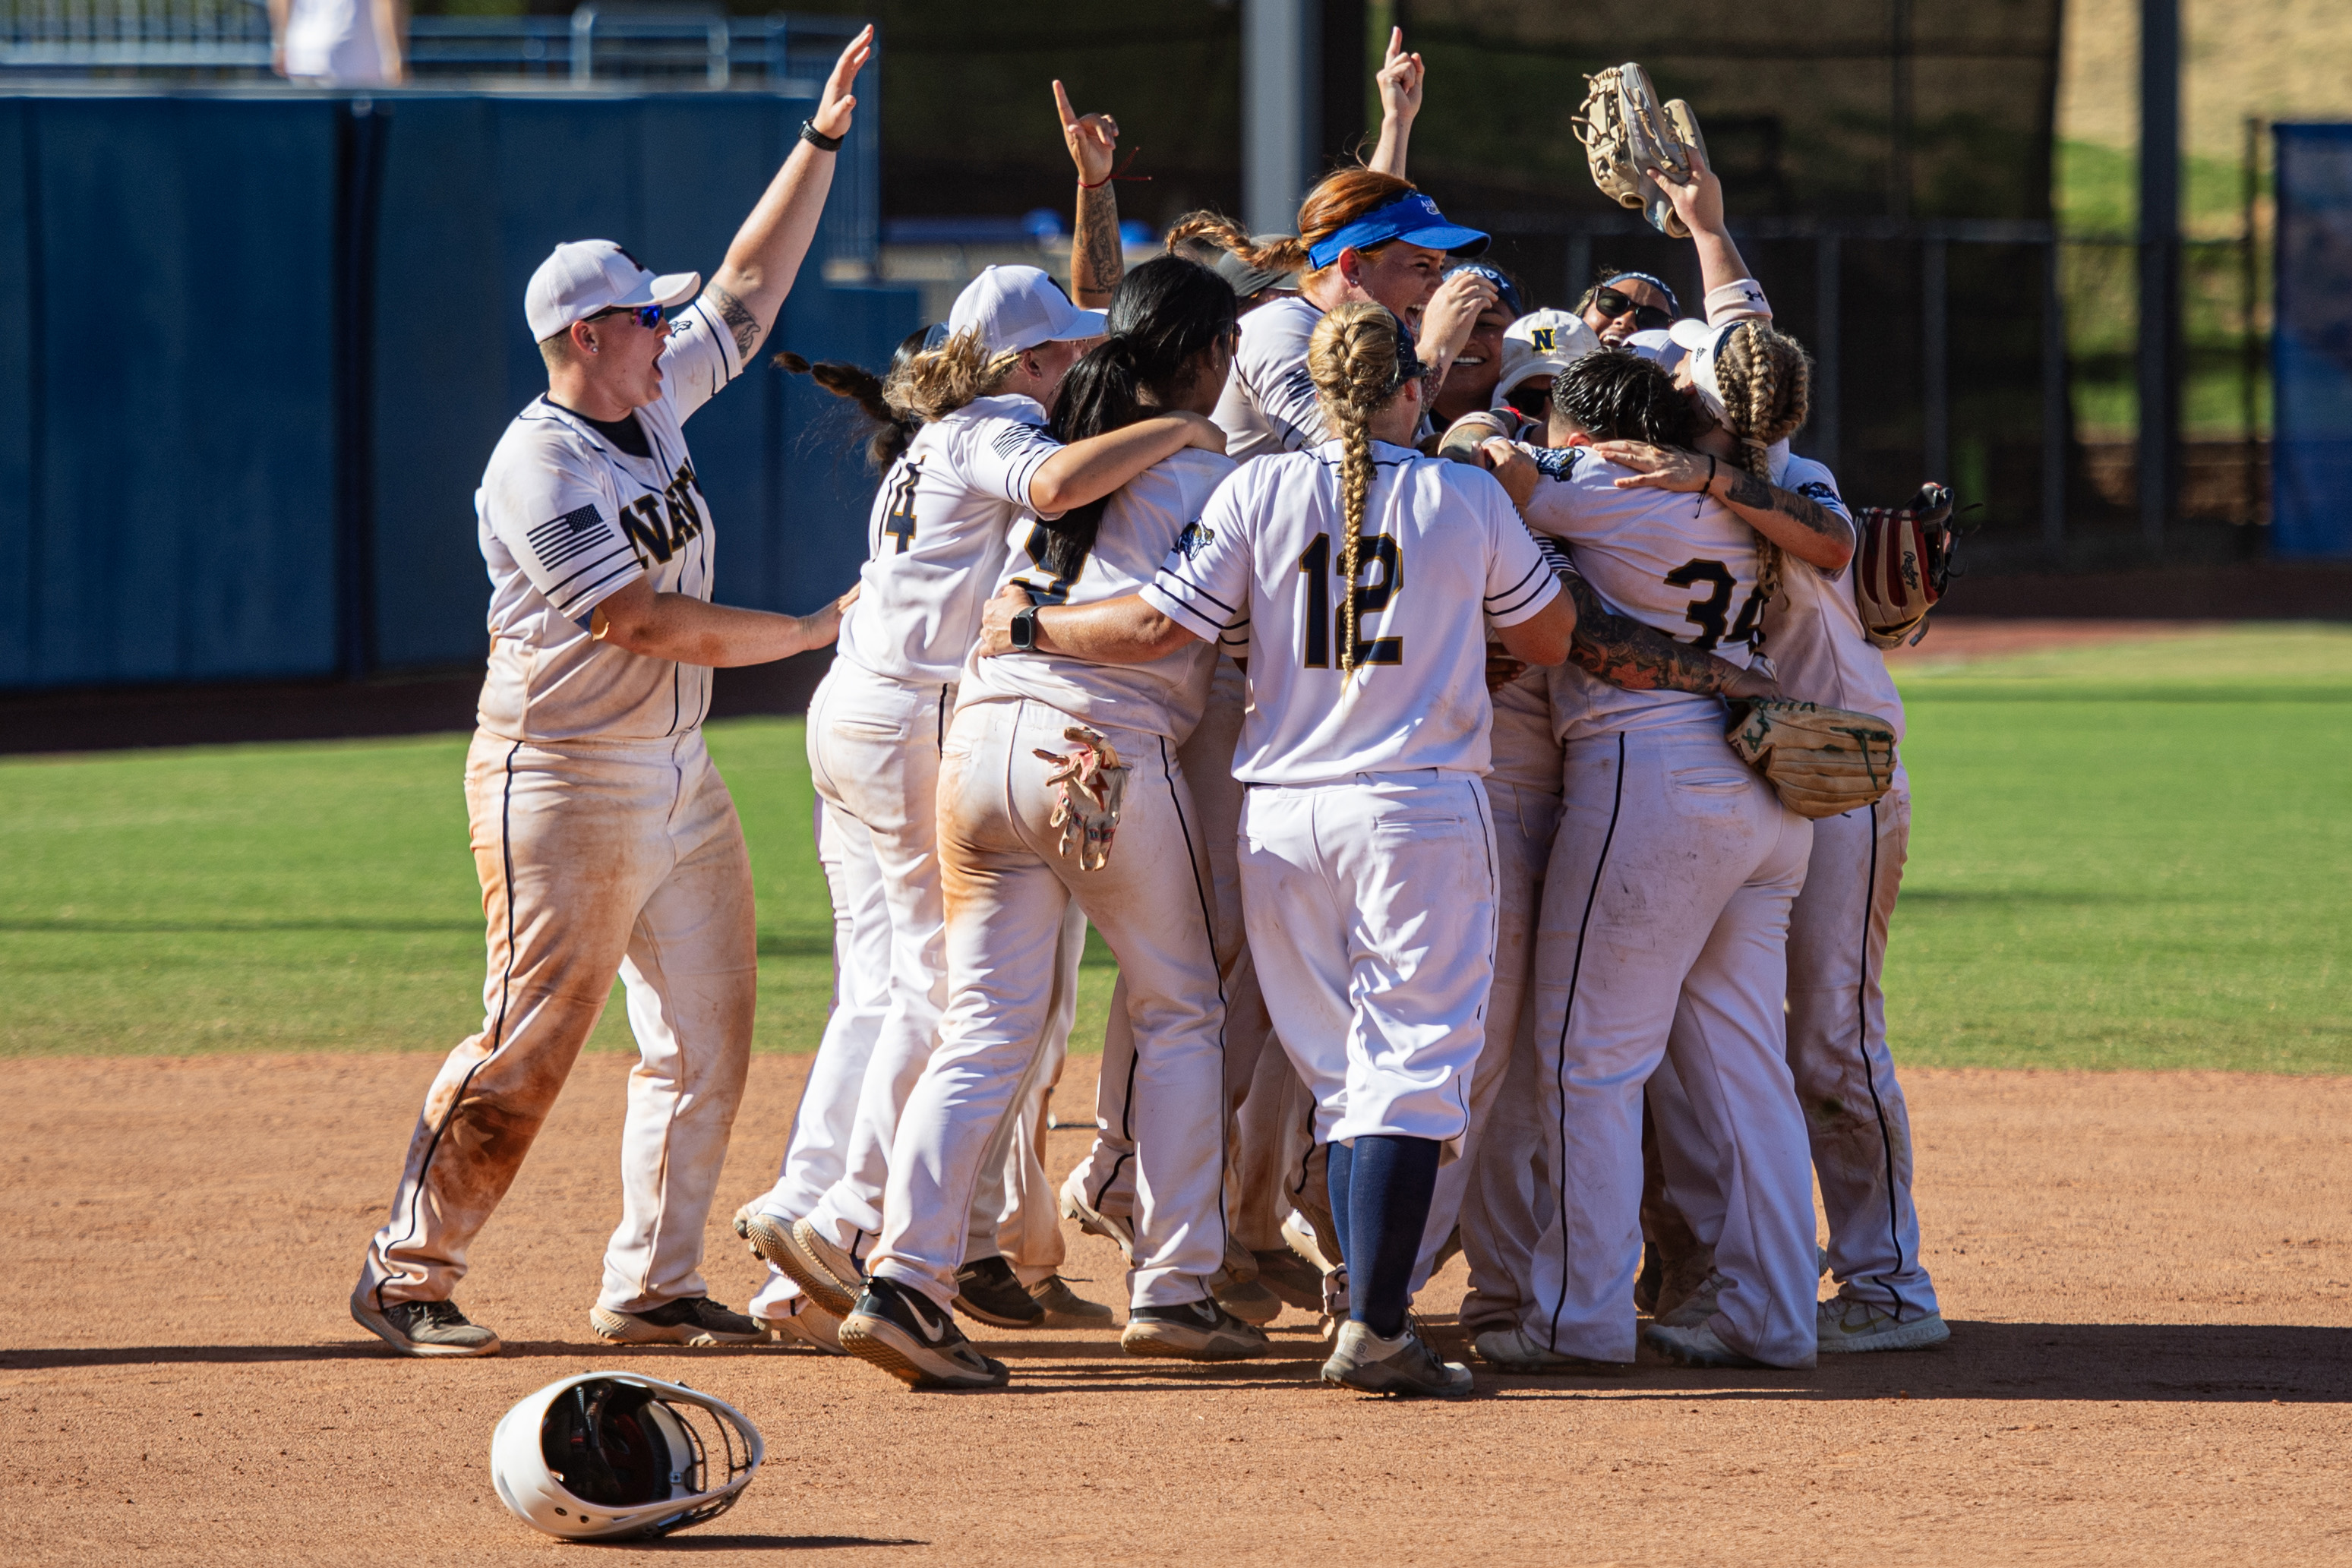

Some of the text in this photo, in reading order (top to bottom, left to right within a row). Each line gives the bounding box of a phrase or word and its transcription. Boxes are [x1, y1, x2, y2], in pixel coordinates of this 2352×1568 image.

[1531, 327, 1557, 353] N
[885, 454, 927, 555] 4
[1298, 532, 1404, 670] 12
